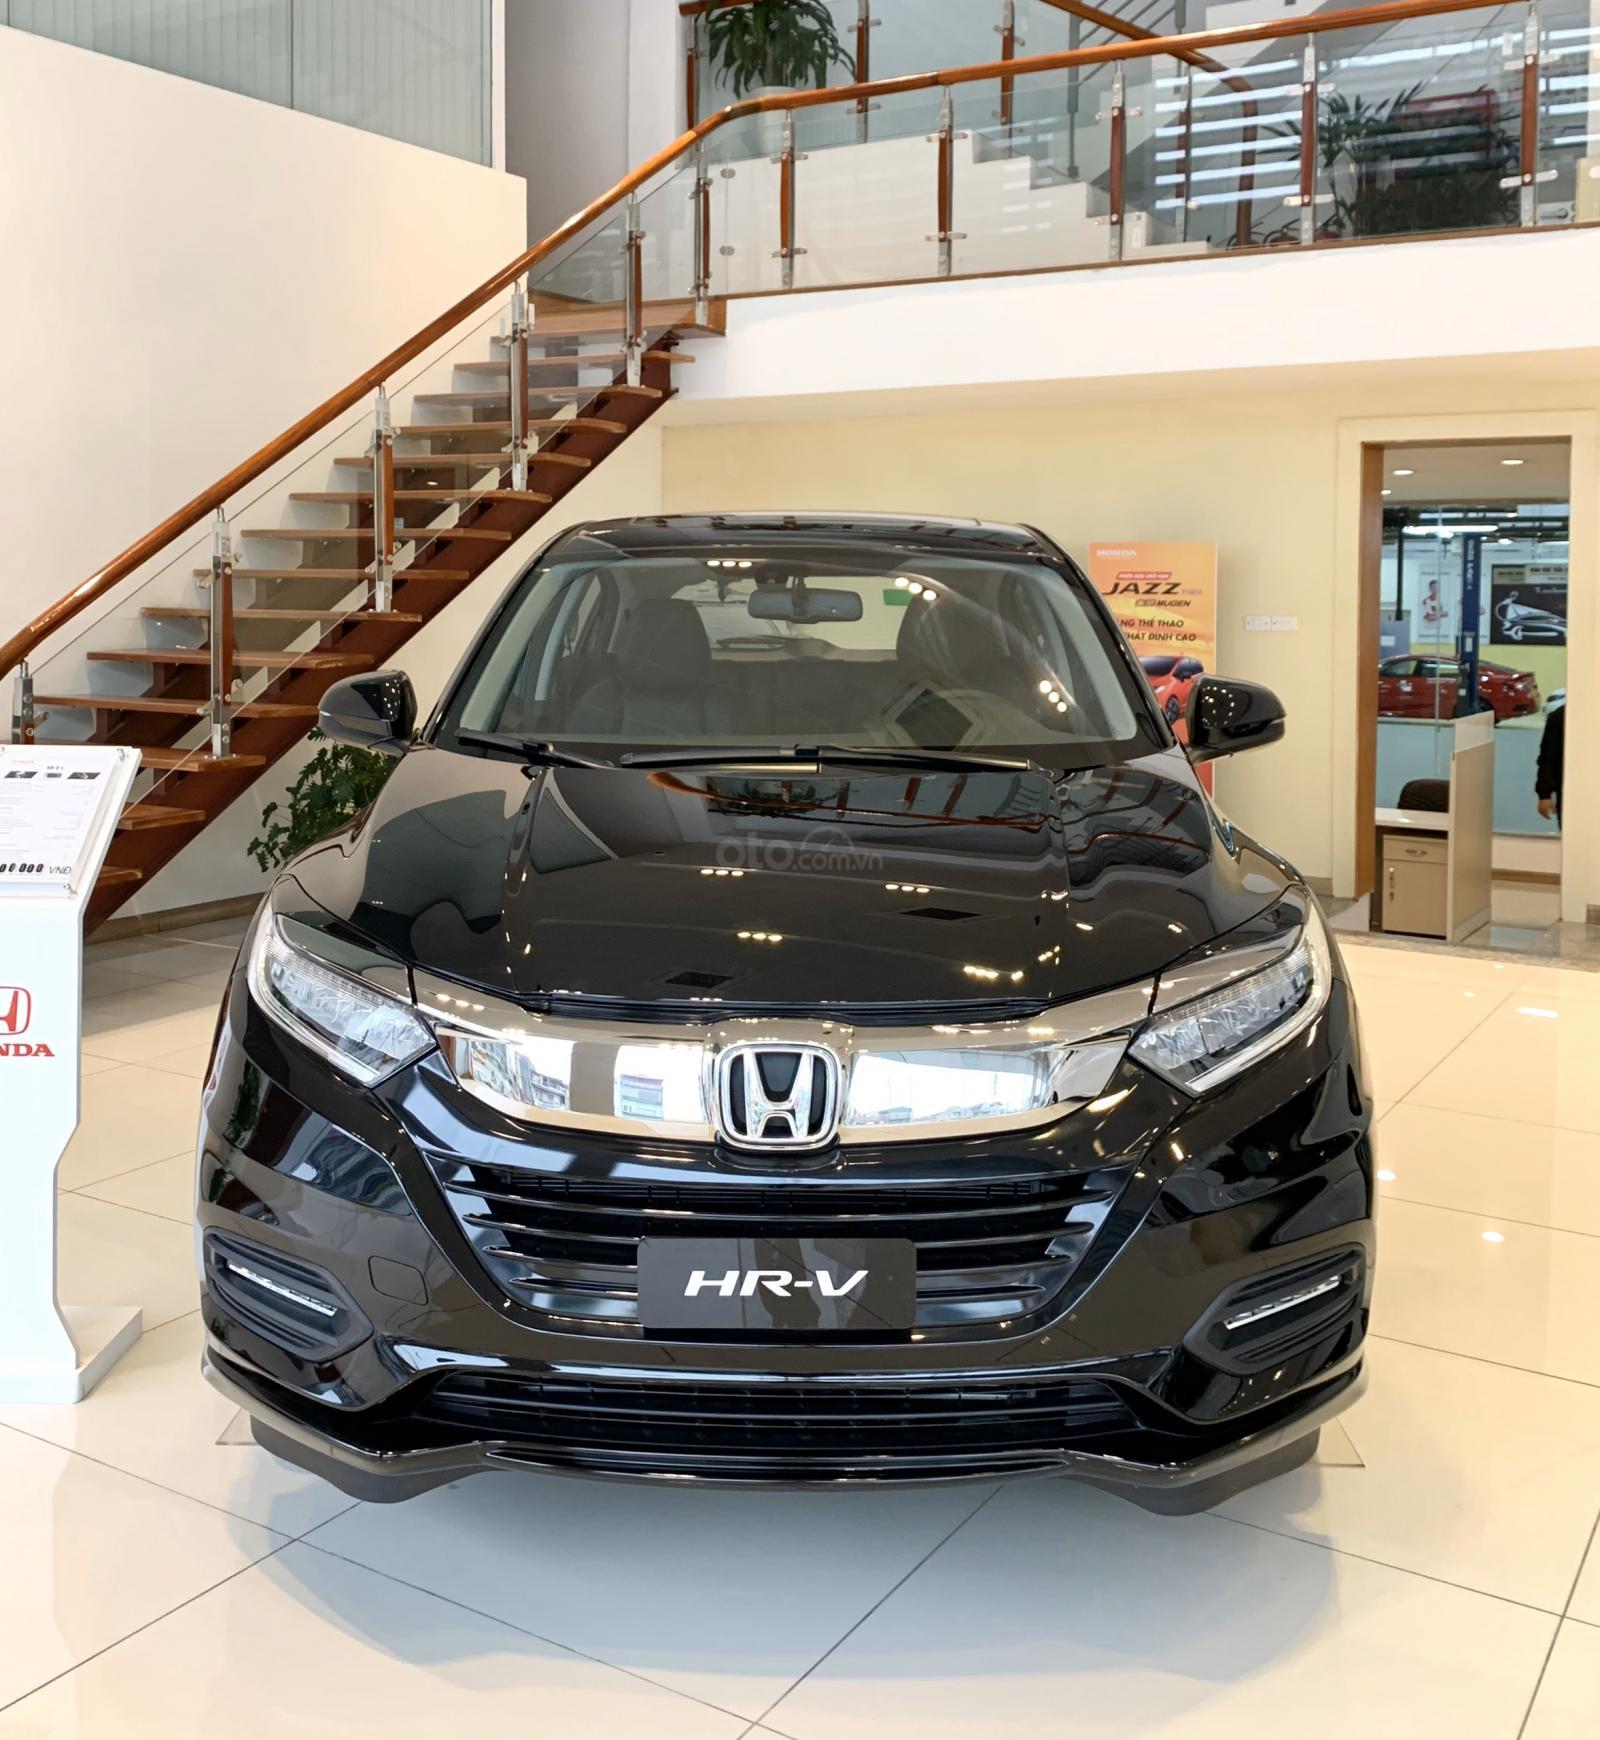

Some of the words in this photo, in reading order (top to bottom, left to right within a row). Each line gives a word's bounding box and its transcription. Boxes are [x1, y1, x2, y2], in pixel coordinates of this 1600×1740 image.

[1101, 582, 1182, 595] JAZZ
[1156, 599, 1192, 608] MUGEN
[1116, 618, 1135, 628] NG
[1158, 619, 1184, 628] THAO
[1175, 632, 1197, 641] CAO
[684, 1270, 869, 1297] HR-V
